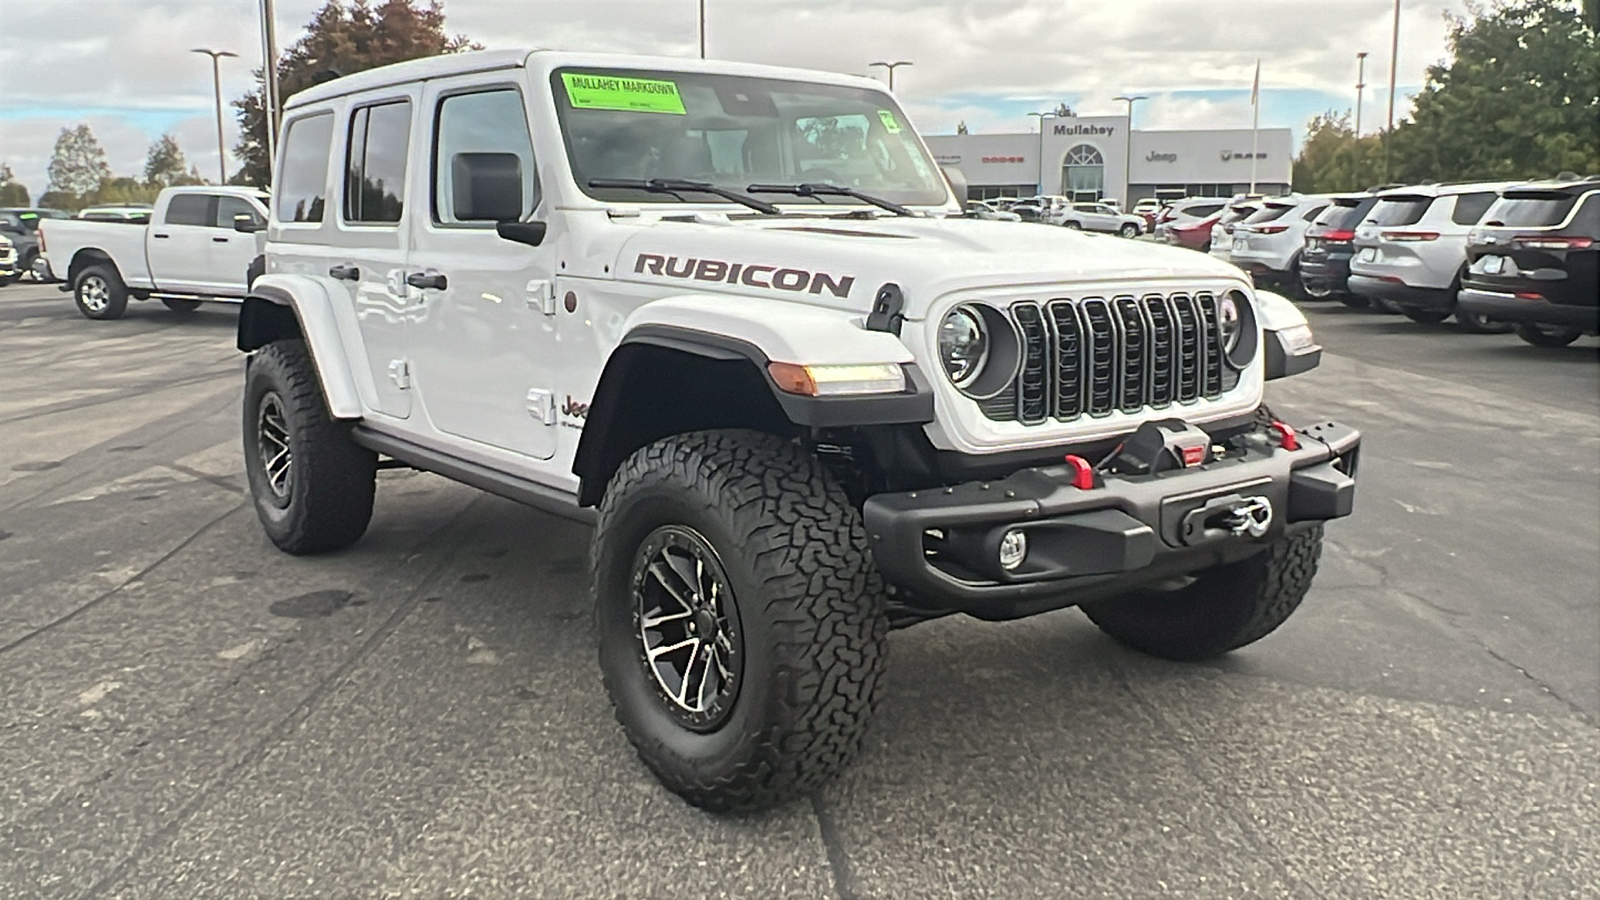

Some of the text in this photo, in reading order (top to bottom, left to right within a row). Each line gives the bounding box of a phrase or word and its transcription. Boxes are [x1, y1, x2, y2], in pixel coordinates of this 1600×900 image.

[571, 77, 675, 95] MULLAHEY MARKDOWN
[1053, 125, 1114, 137] Mullahey
[982, 156, 1025, 164] DODGE
[634, 253, 856, 298] RUBICON
[562, 395, 590, 419] Jee
